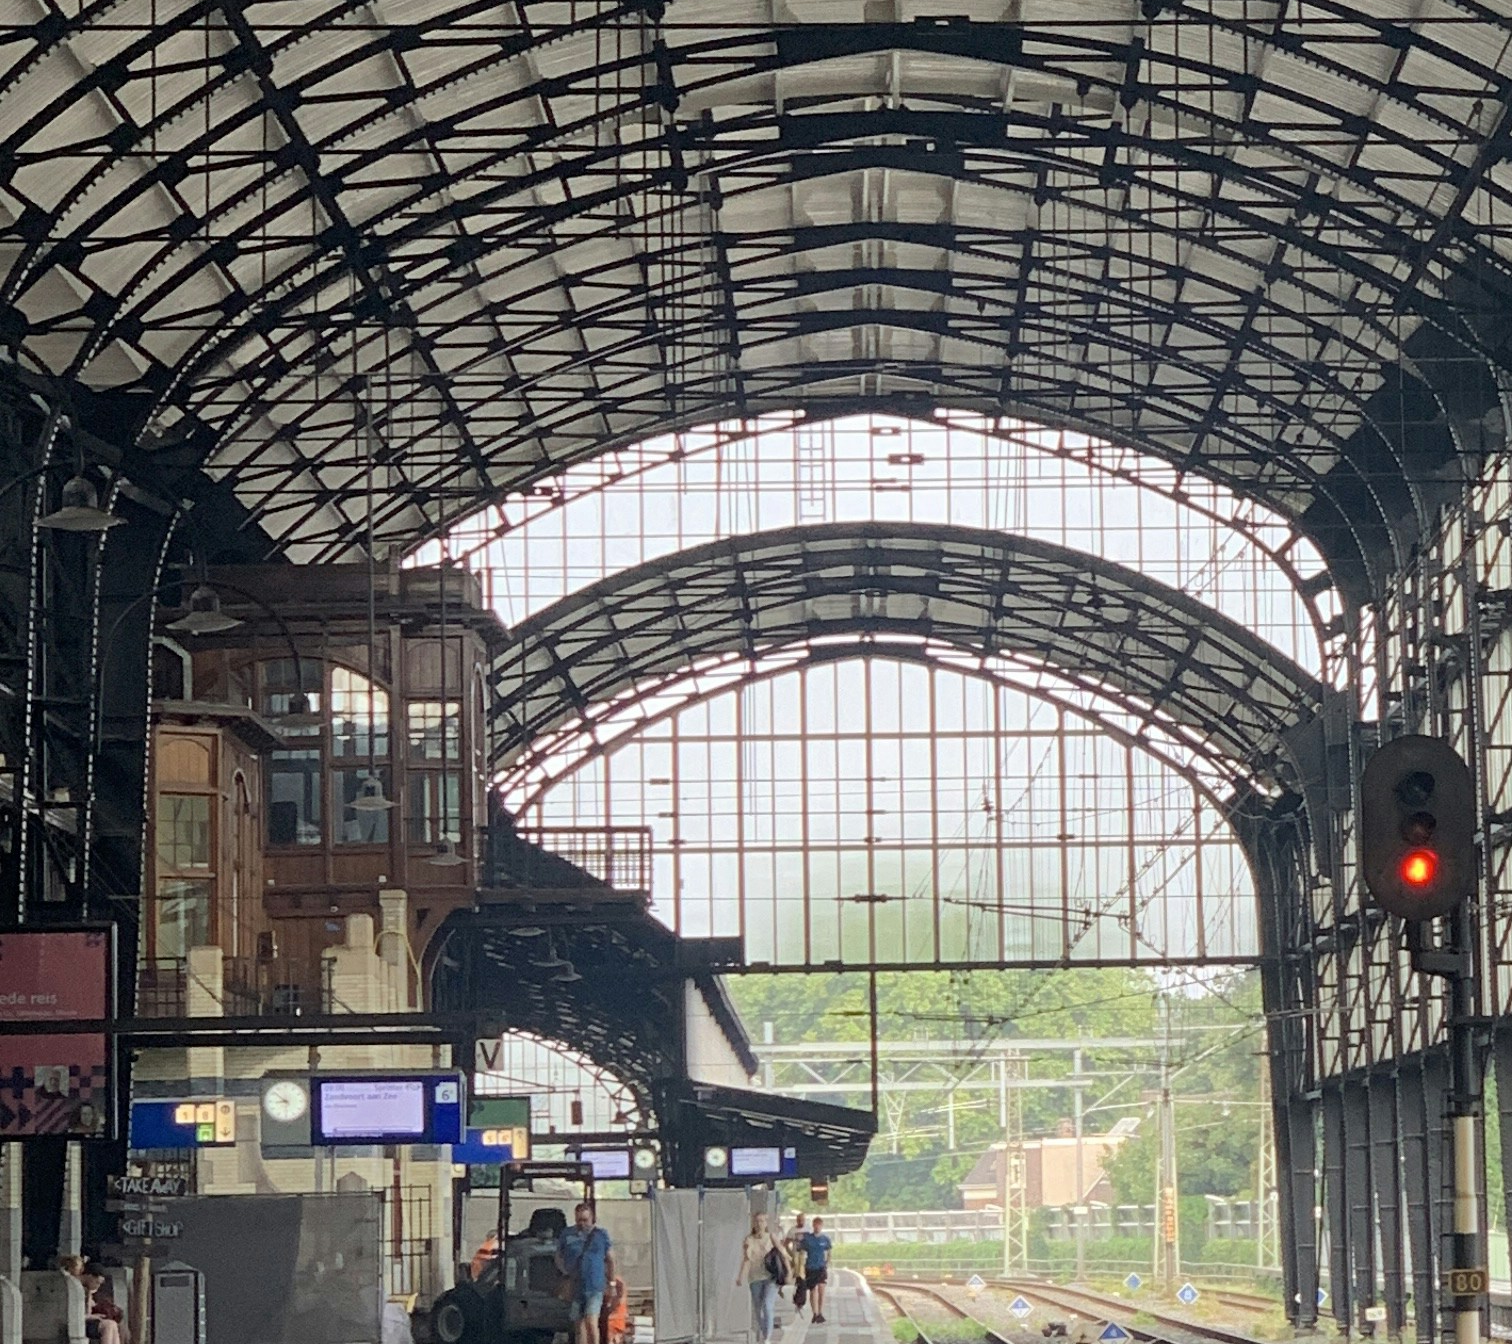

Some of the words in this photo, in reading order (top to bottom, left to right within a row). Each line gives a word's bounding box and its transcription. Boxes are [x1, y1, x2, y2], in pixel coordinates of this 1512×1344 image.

[31, 993, 57, 1005] reis
[479, 1041, 501, 1069] V
[1456, 1274, 1481, 1292] 80
